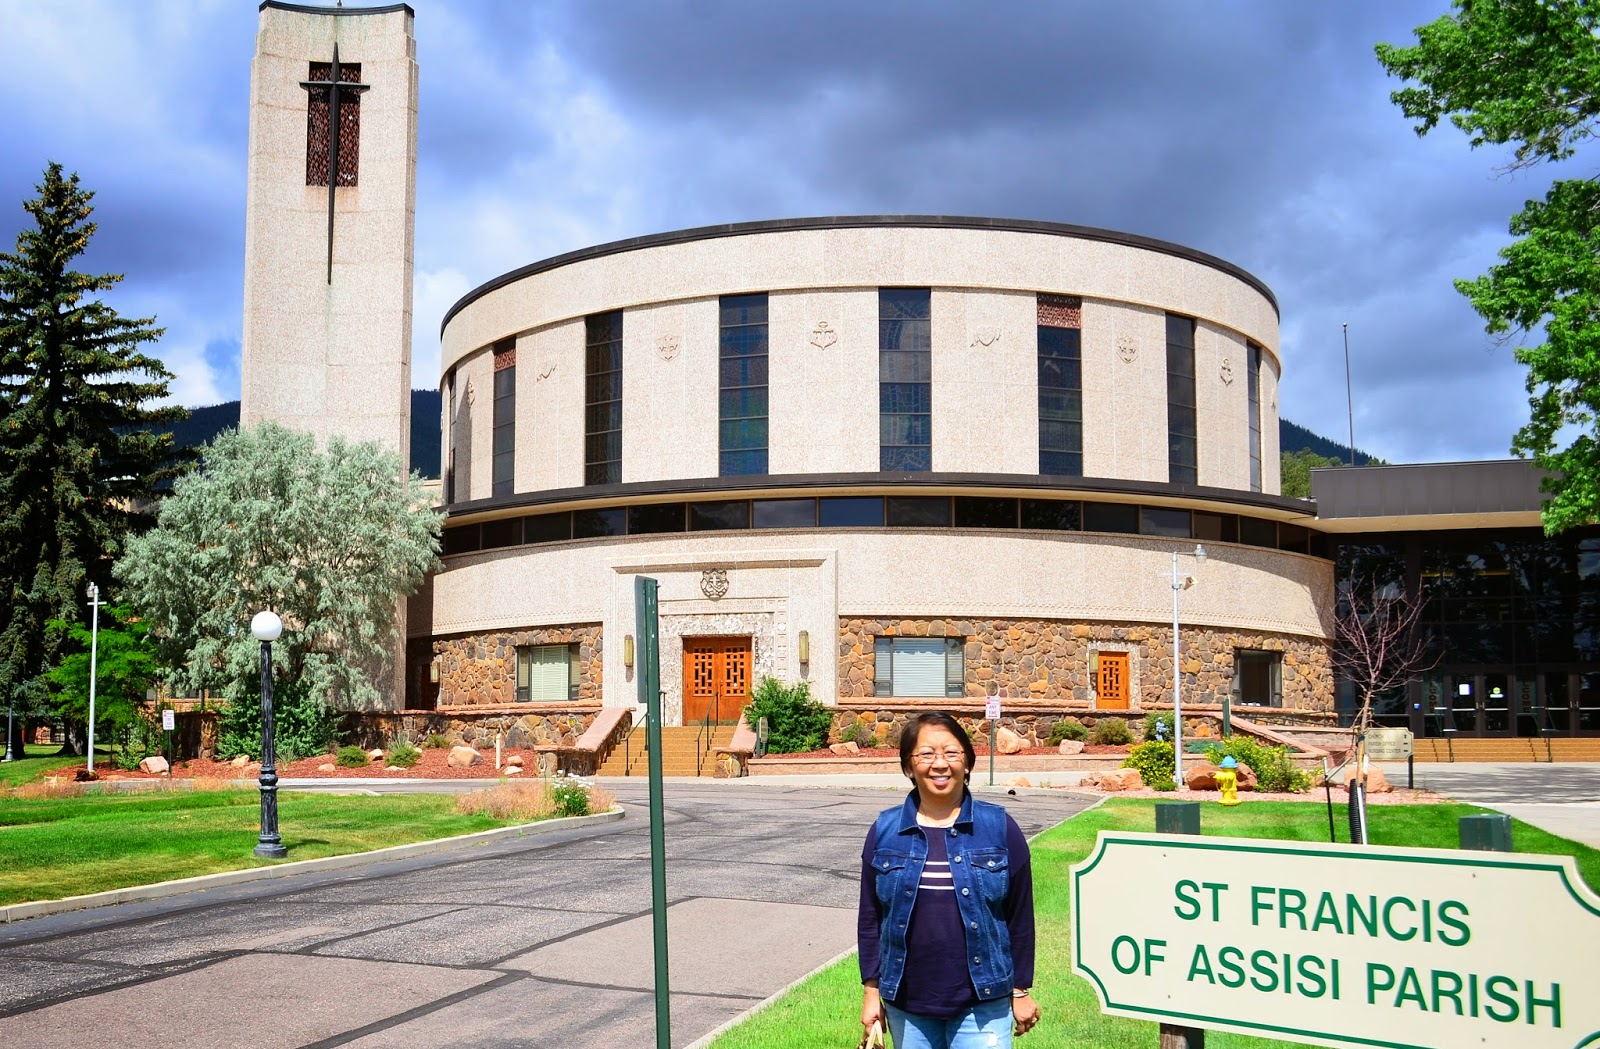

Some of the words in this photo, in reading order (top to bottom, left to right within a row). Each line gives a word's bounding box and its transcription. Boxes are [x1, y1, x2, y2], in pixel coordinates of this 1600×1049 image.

[1174, 879, 1228, 921] ST
[1251, 886, 1471, 947] FRANCIS
[1111, 935, 1167, 976] OF
[1187, 944, 1340, 1000] ASSISI
[1366, 962, 1561, 1028] PARISH
